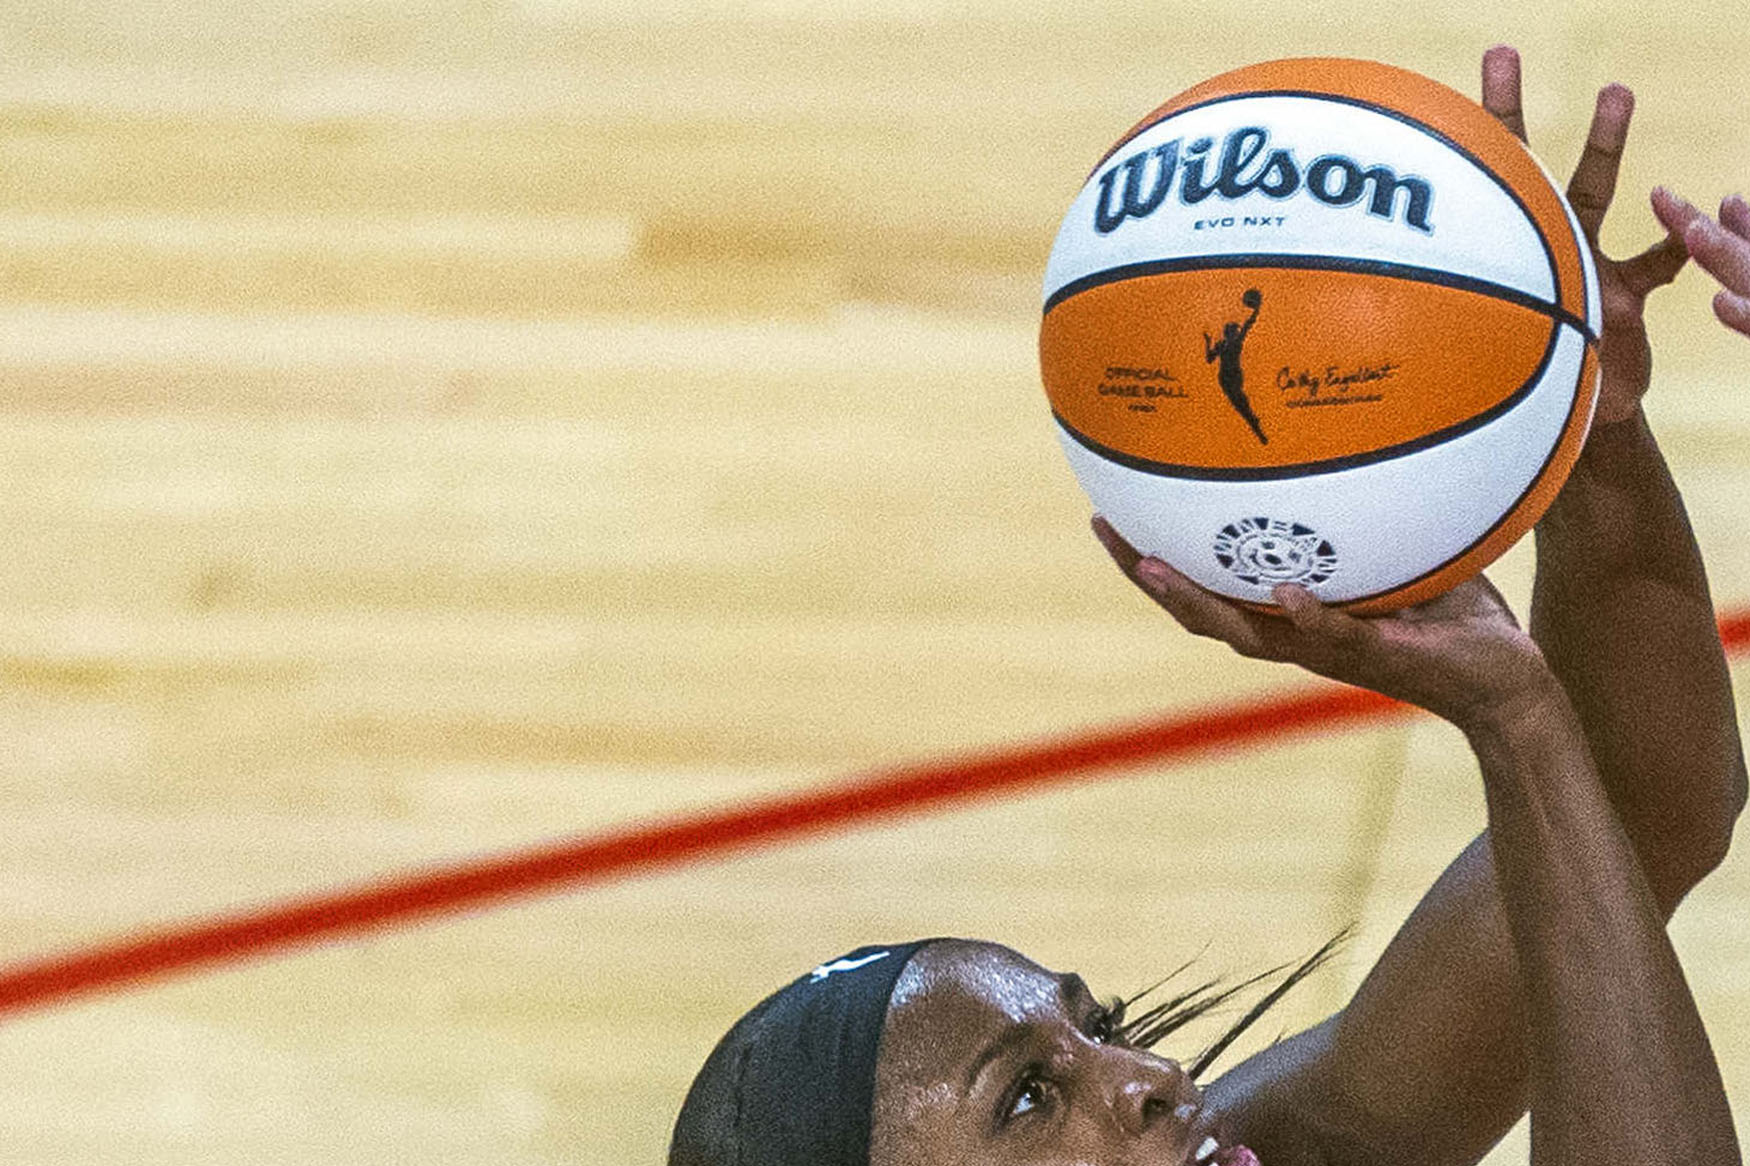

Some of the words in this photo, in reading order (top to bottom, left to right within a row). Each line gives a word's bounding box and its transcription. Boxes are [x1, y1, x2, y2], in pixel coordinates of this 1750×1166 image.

[1094, 126, 1434, 237] Wilson
[1193, 217, 1236, 230] EVO
[1243, 216, 1286, 227] NXT
